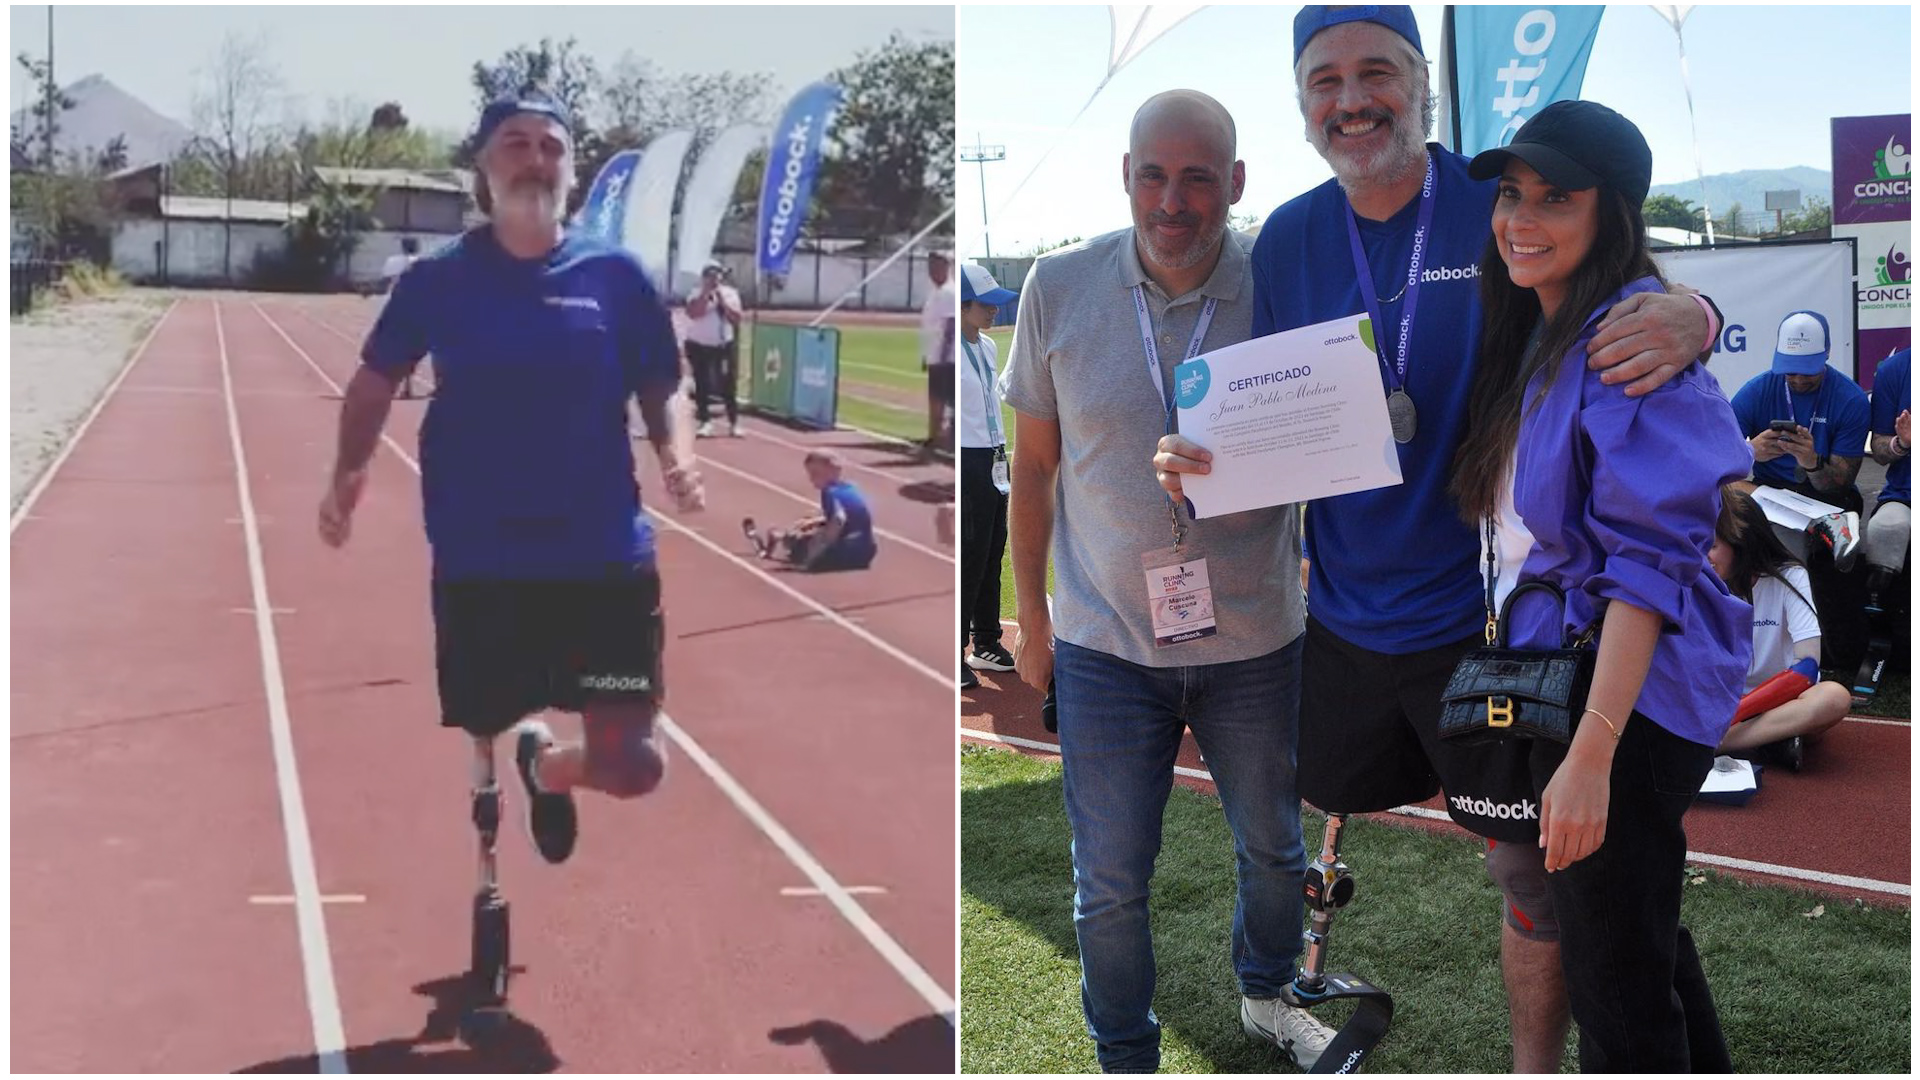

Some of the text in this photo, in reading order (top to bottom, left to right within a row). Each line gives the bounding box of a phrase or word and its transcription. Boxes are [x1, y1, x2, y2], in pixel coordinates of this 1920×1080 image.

[768, 115, 812, 257] ottobock.
[1408, 225, 1425, 286] ottobock.
[1324, 334, 1358, 346] ottobock.
[1399, 313, 1411, 375] ottobock.
[1228, 365, 1312, 392] CERTIFICADO
[1209, 400, 1245, 421] Juan
[1248, 390, 1283, 409] Pablo
[1285, 382, 1338, 400] Medina
[1169, 594, 1196, 604] Marcelo
[1172, 631, 1203, 642] ottobock.
[1449, 795, 1539, 820] ottobock
